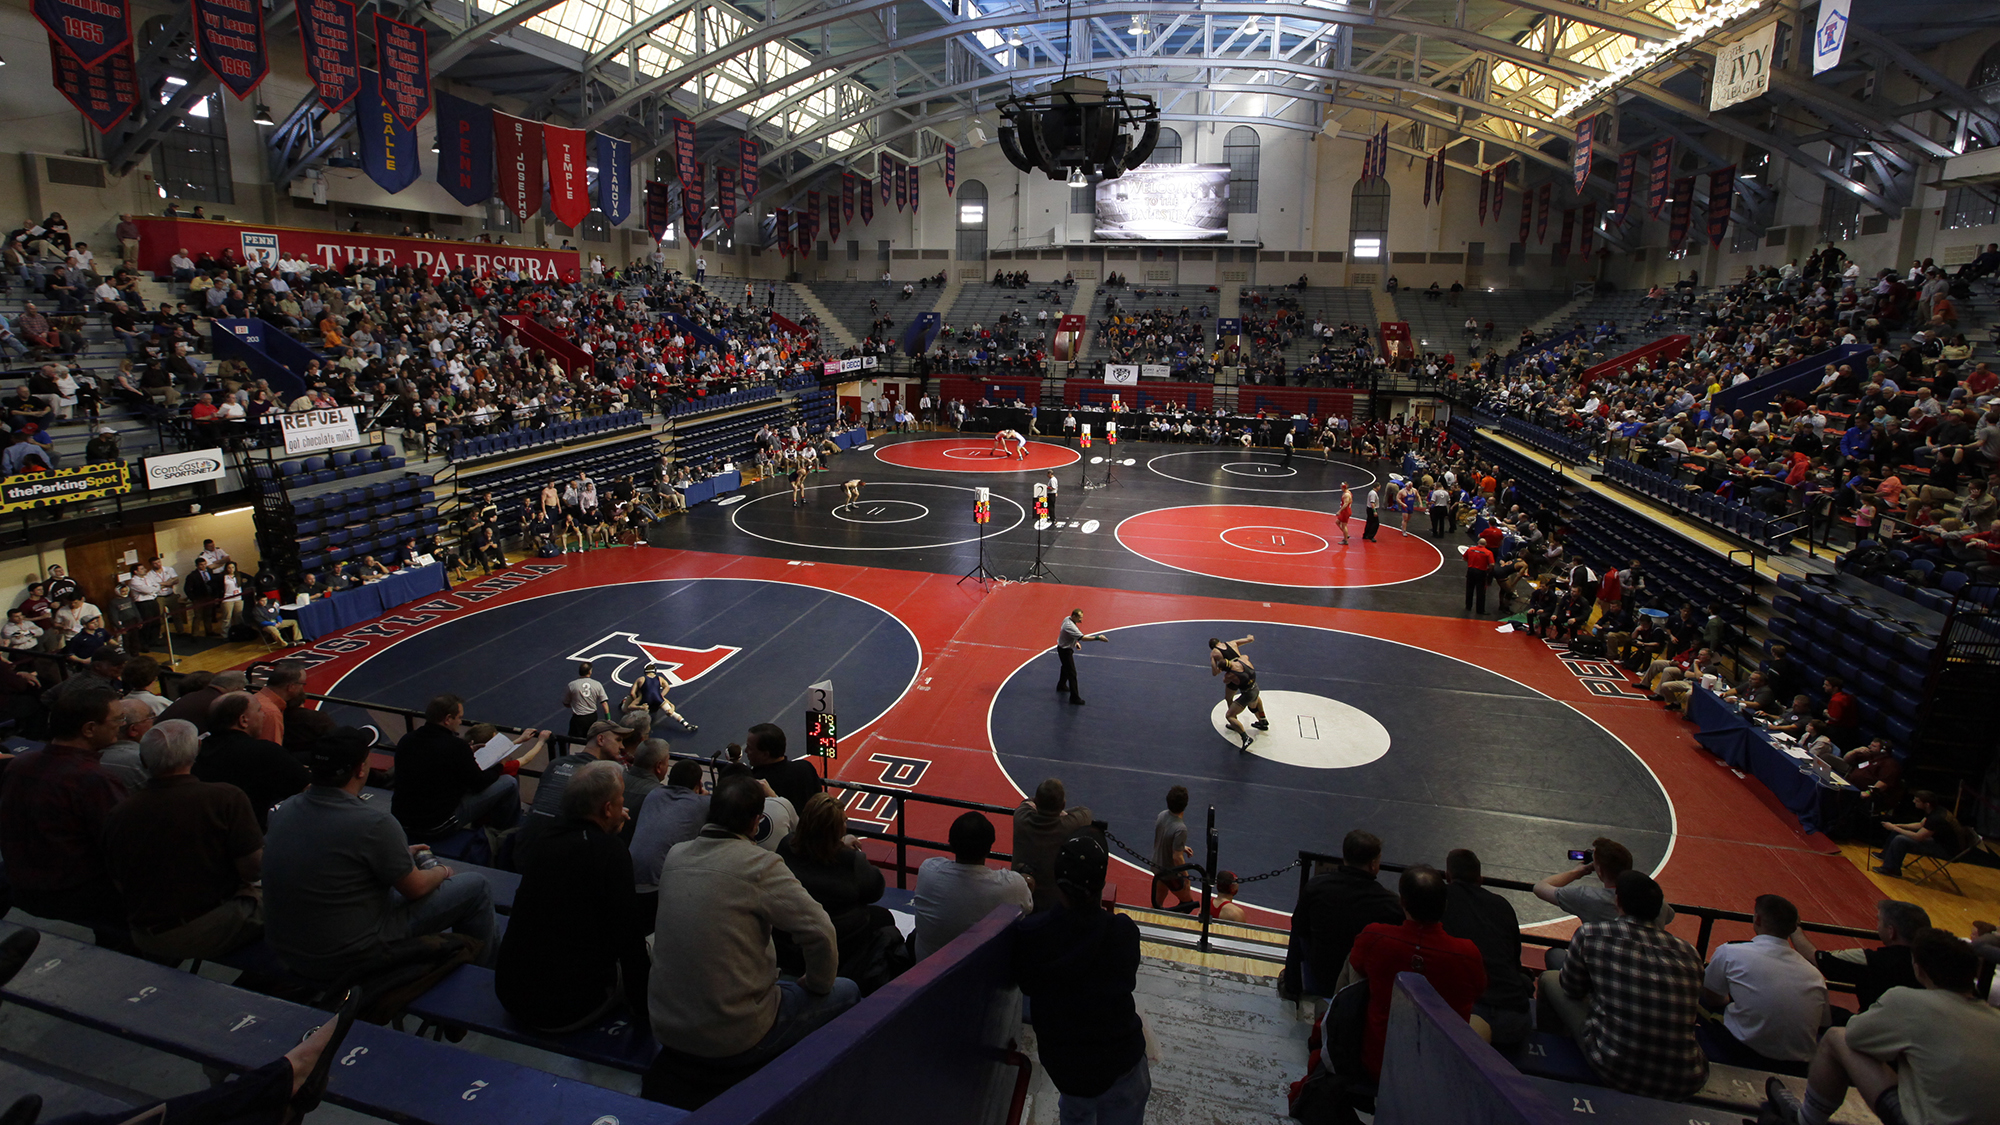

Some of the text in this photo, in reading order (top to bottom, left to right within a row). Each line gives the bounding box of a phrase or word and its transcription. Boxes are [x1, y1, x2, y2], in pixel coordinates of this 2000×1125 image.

[60, 0, 121, 18] ampions
[204, 0, 252, 13] sketball
[62, 16, 104, 45] 1955
[202, 10, 256, 35] Ivy League
[206, 29, 257, 53] Champions
[318, 47, 340, 62] NCAA
[219, 55, 252, 78] 1966
[1728, 45, 1769, 86] IVY
[320, 82, 344, 100] 1971
[1726, 74, 1765, 101] LEAGUE
[398, 103, 417, 119] 1972
[383, 113, 396, 171] SALLE
[459, 120, 471, 189] PENN
[563, 144, 573, 200] TEMPLE
[610, 141, 620, 218] VILLANOVA
[517, 152, 527, 219] JOSEPHS
[1127, 181, 1200, 195] WELCOME
[1145, 197, 1179, 207] TO THE
[1129, 208, 1195, 221] PALESTRA
[245, 236, 274, 245] PENN
[316, 243, 559, 282] THE PALESTRA
[284, 409, 348, 430] REFUEL
[289, 438, 300, 451] got
[302, 432, 336, 448] chocolate
[164, 467, 212, 480] SPORTSNET
[8, 474, 118, 498] theParkingSpot
[1036, 486, 1044, 497] 2
[582, 683, 591, 698] 3
[812, 688, 827, 712] 3
[818, 713, 834, 724] 179
[828, 724, 835, 736] 2
[229, 1014, 257, 1032] 4
[340, 1046, 369, 1066] 3
[1528, 1043, 1548, 1057] 17
[461, 1079, 489, 1101] 2
[1572, 1097, 1597, 1114] 17
